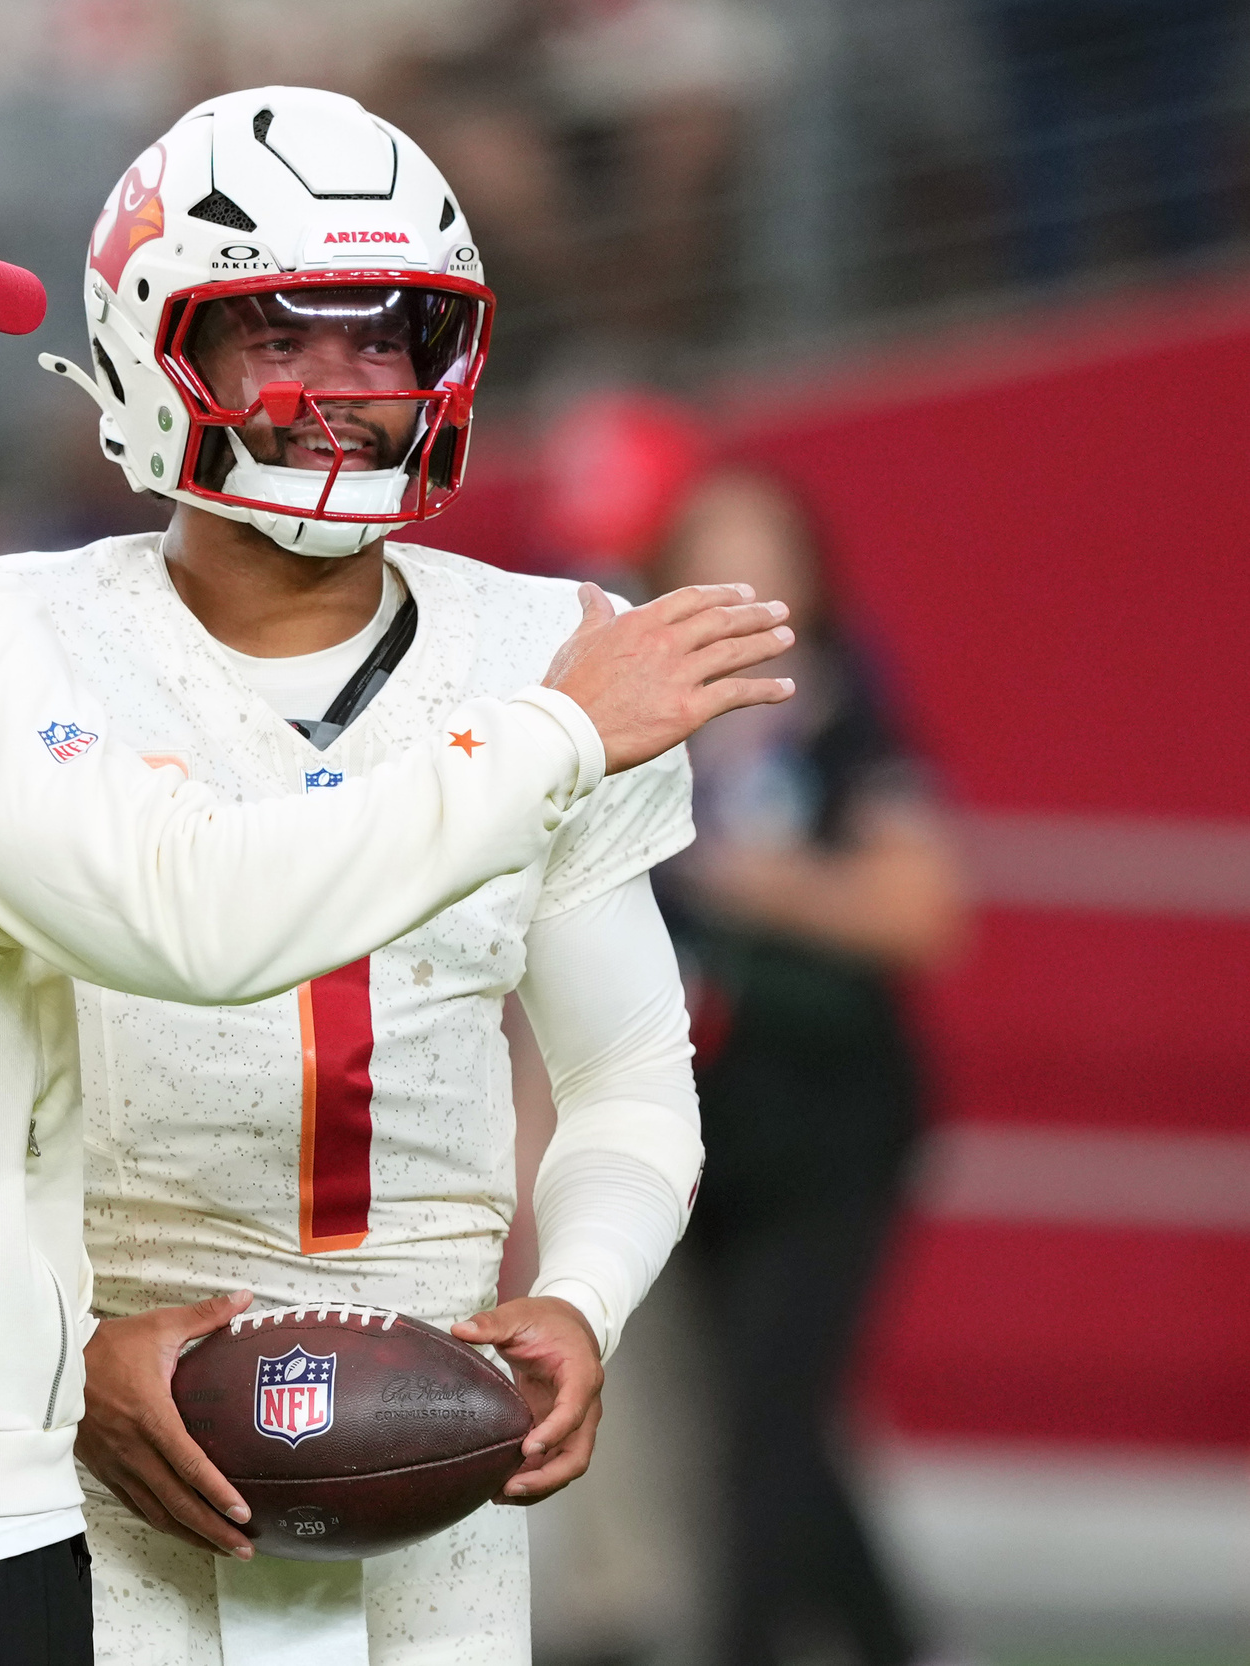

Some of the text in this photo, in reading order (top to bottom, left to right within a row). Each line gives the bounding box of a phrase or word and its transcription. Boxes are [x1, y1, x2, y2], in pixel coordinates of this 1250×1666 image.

[323, 231, 410, 244] ARIZONA
[211, 262, 270, 270] OAKLEY
[52, 737, 94, 761] NFL
[263, 1387, 324, 1432] NFL
[375, 1409, 477, 1421] COMMISSIONER
[294, 1521, 326, 1535] 259
